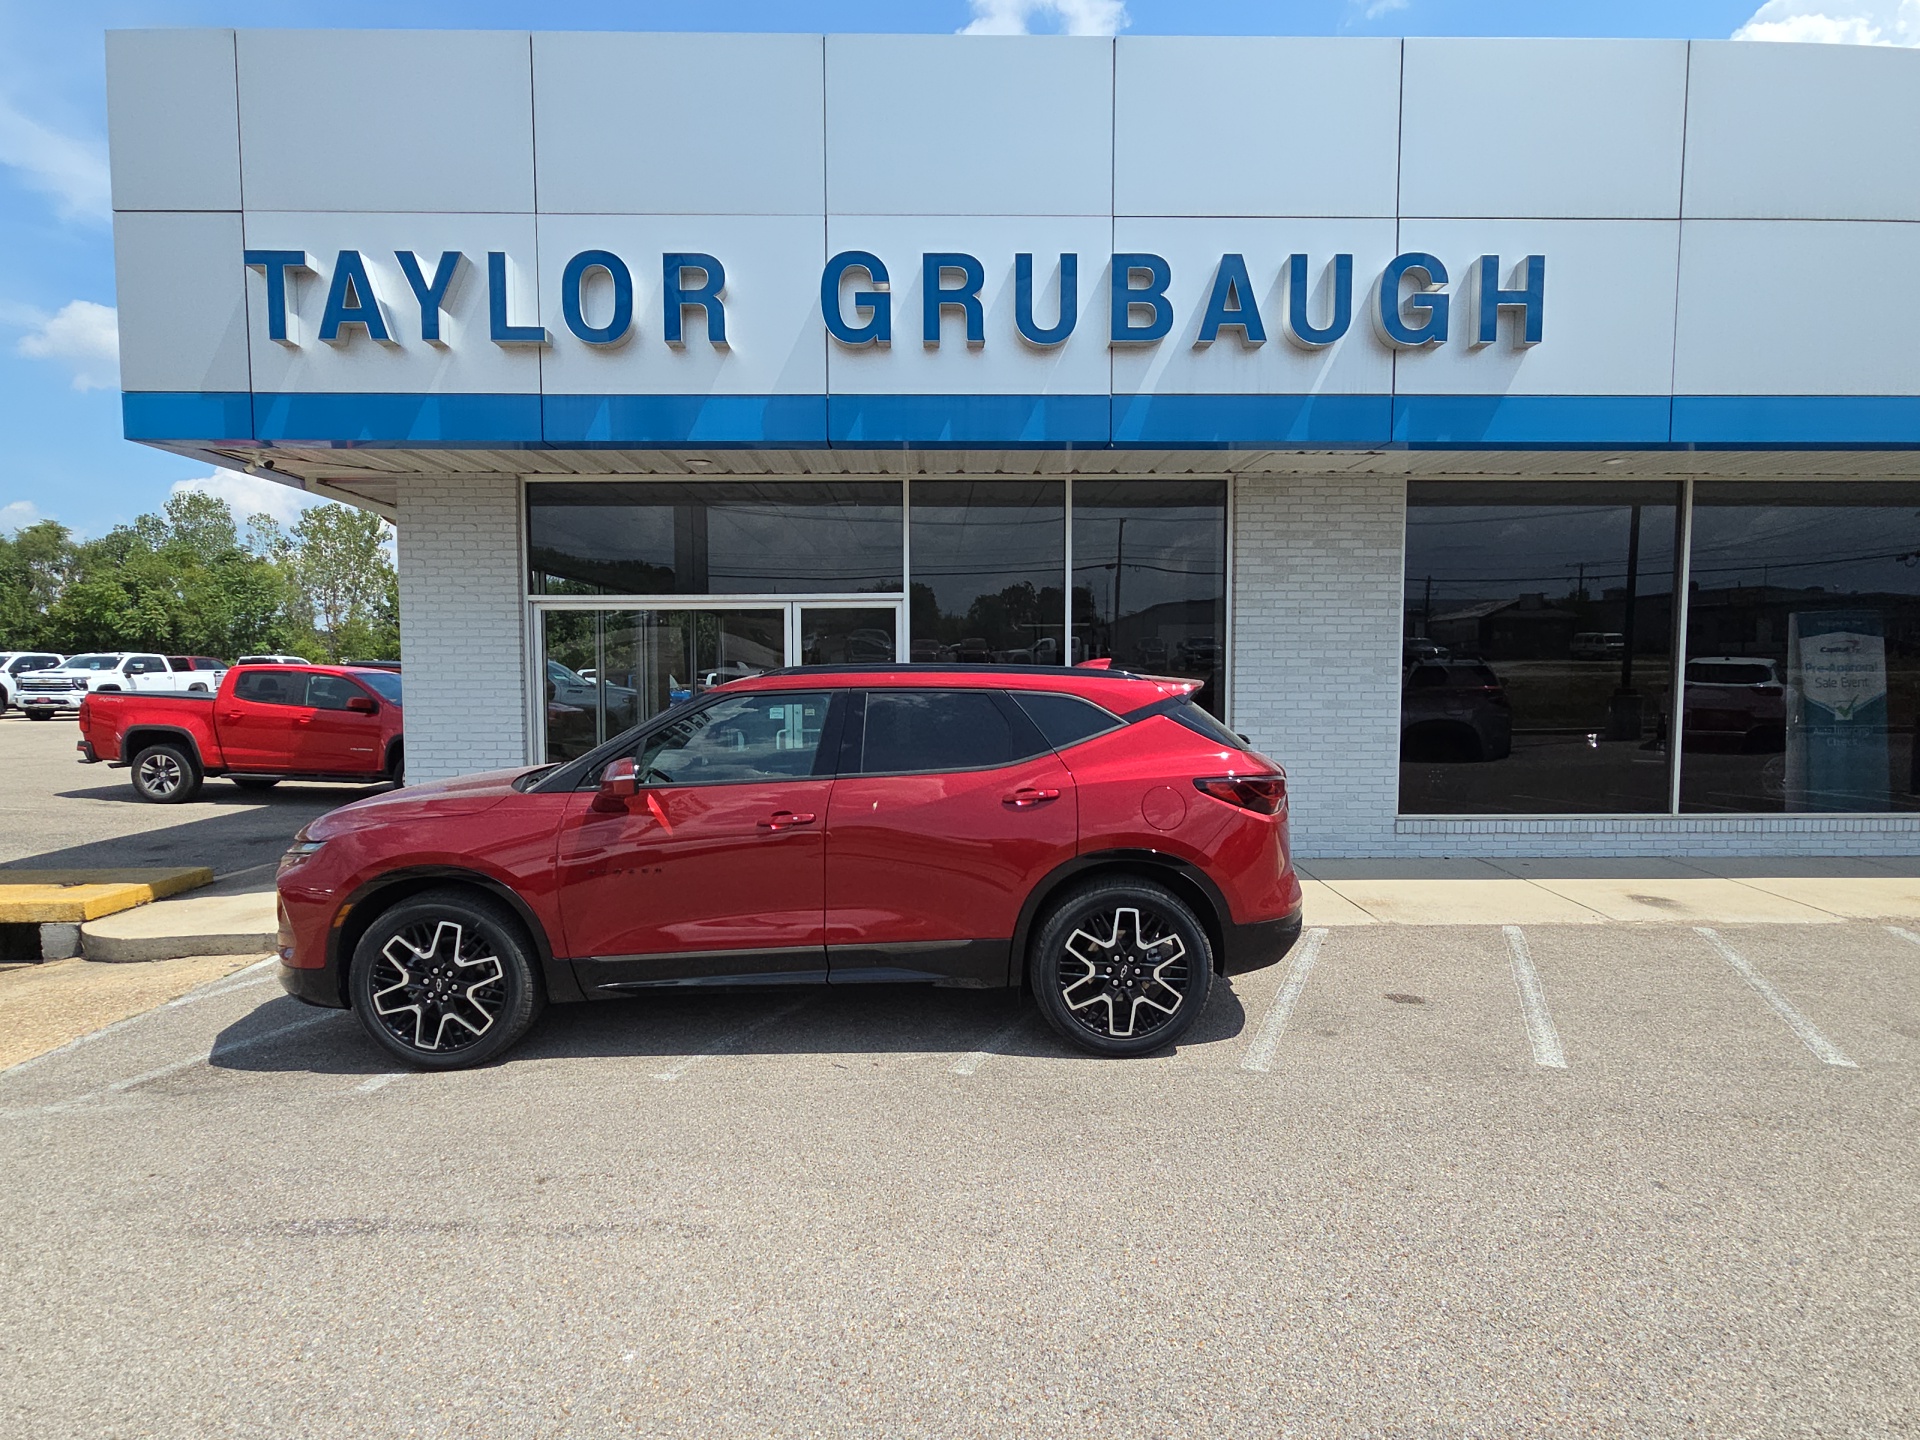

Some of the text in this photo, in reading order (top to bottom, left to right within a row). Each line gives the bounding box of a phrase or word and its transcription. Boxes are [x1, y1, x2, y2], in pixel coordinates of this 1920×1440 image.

[244, 250, 1546, 350] TAYLOR GRUBAUGH
[1815, 677, 1869, 688] Sale Event
